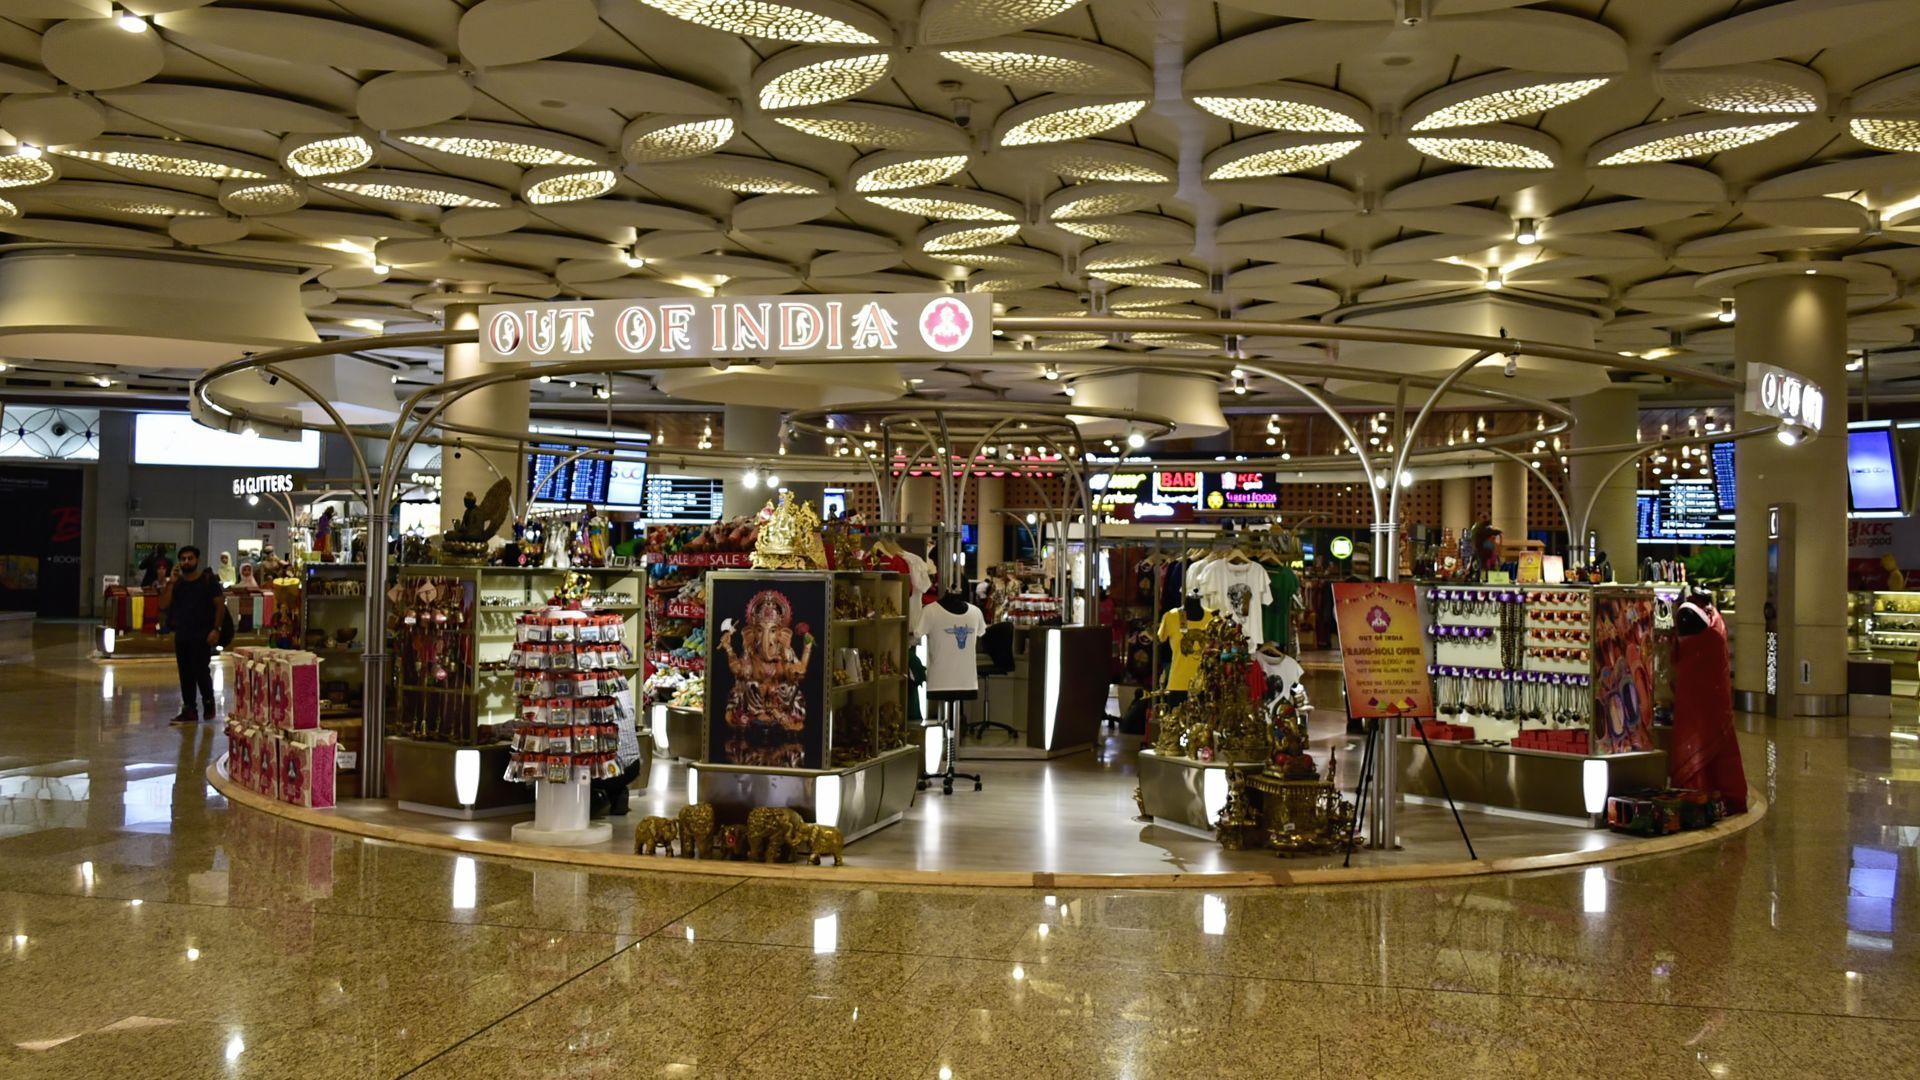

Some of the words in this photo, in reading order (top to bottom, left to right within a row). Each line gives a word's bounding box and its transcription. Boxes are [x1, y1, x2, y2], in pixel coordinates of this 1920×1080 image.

[488, 307, 595, 356] OUT
[615, 305, 696, 353] OF
[711, 302, 899, 352] INDIA
[1161, 472, 1196, 487] BAR
[1238, 473, 1263, 482] KFC
[1860, 522, 1894, 535] KFC
[668, 554, 689, 565] SALE
[709, 554, 740, 566] SALE
[668, 604, 689, 616] SALE
[669, 655, 689, 668] SALE
